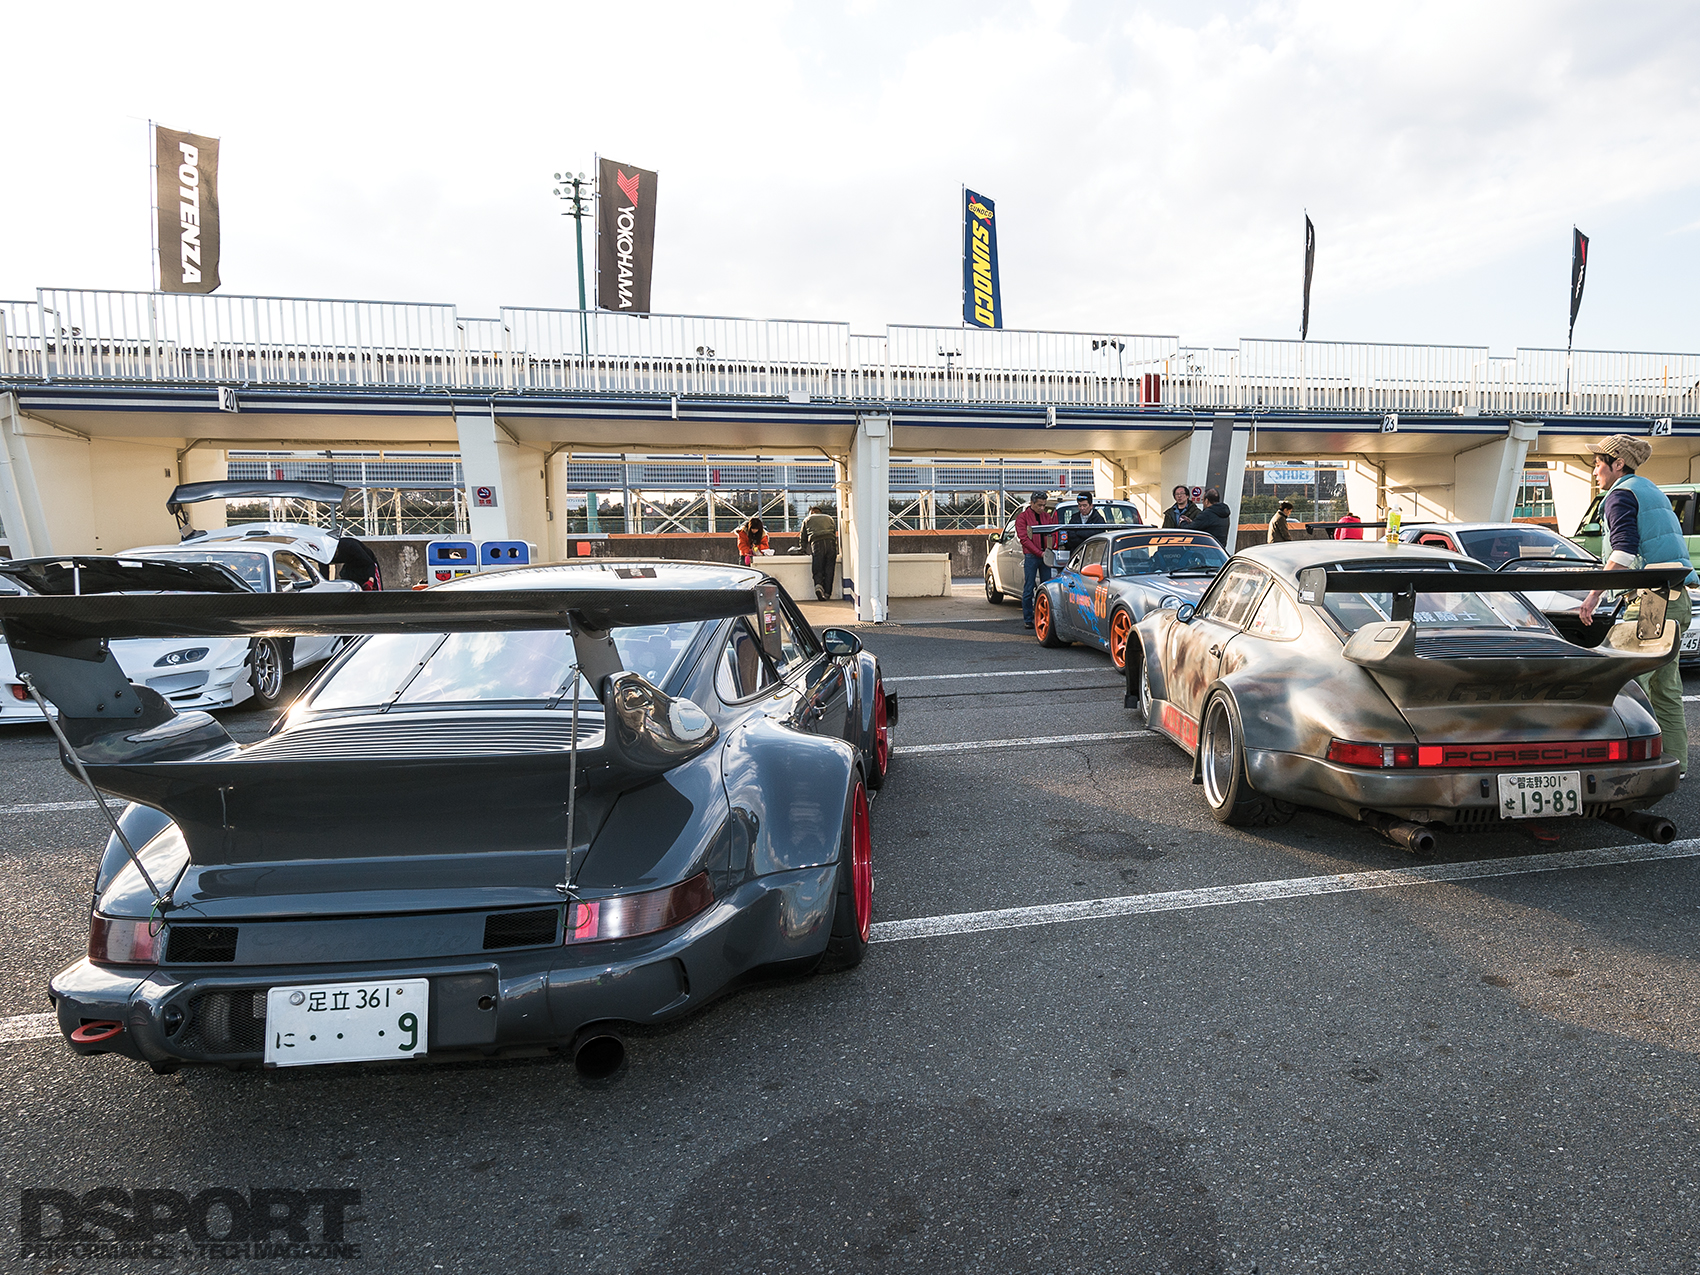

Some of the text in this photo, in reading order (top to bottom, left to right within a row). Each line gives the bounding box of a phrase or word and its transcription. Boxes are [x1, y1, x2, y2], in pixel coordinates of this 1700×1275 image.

[178, 141, 202, 284] POTENZA
[969, 204, 992, 218] SUNOCO
[616, 206, 635, 309] YOKOHAMA
[972, 219, 995, 328] SUNOCO
[224, 388, 235, 411] 20
[1385, 416, 1395, 431] 23
[1655, 419, 1669, 435] 24
[1274, 470, 1309, 480] SHOEI
[1148, 537, 1194, 545] UZI
[1094, 585, 1108, 619] 88
[1445, 747, 1607, 762] PORSCHE
[1516, 774, 1563, 789] 習志野 301
[1504, 789, 1578, 814] せ 19-89
[307, 989, 391, 1012] 足立 361
[275, 1032, 296, 1049] に
